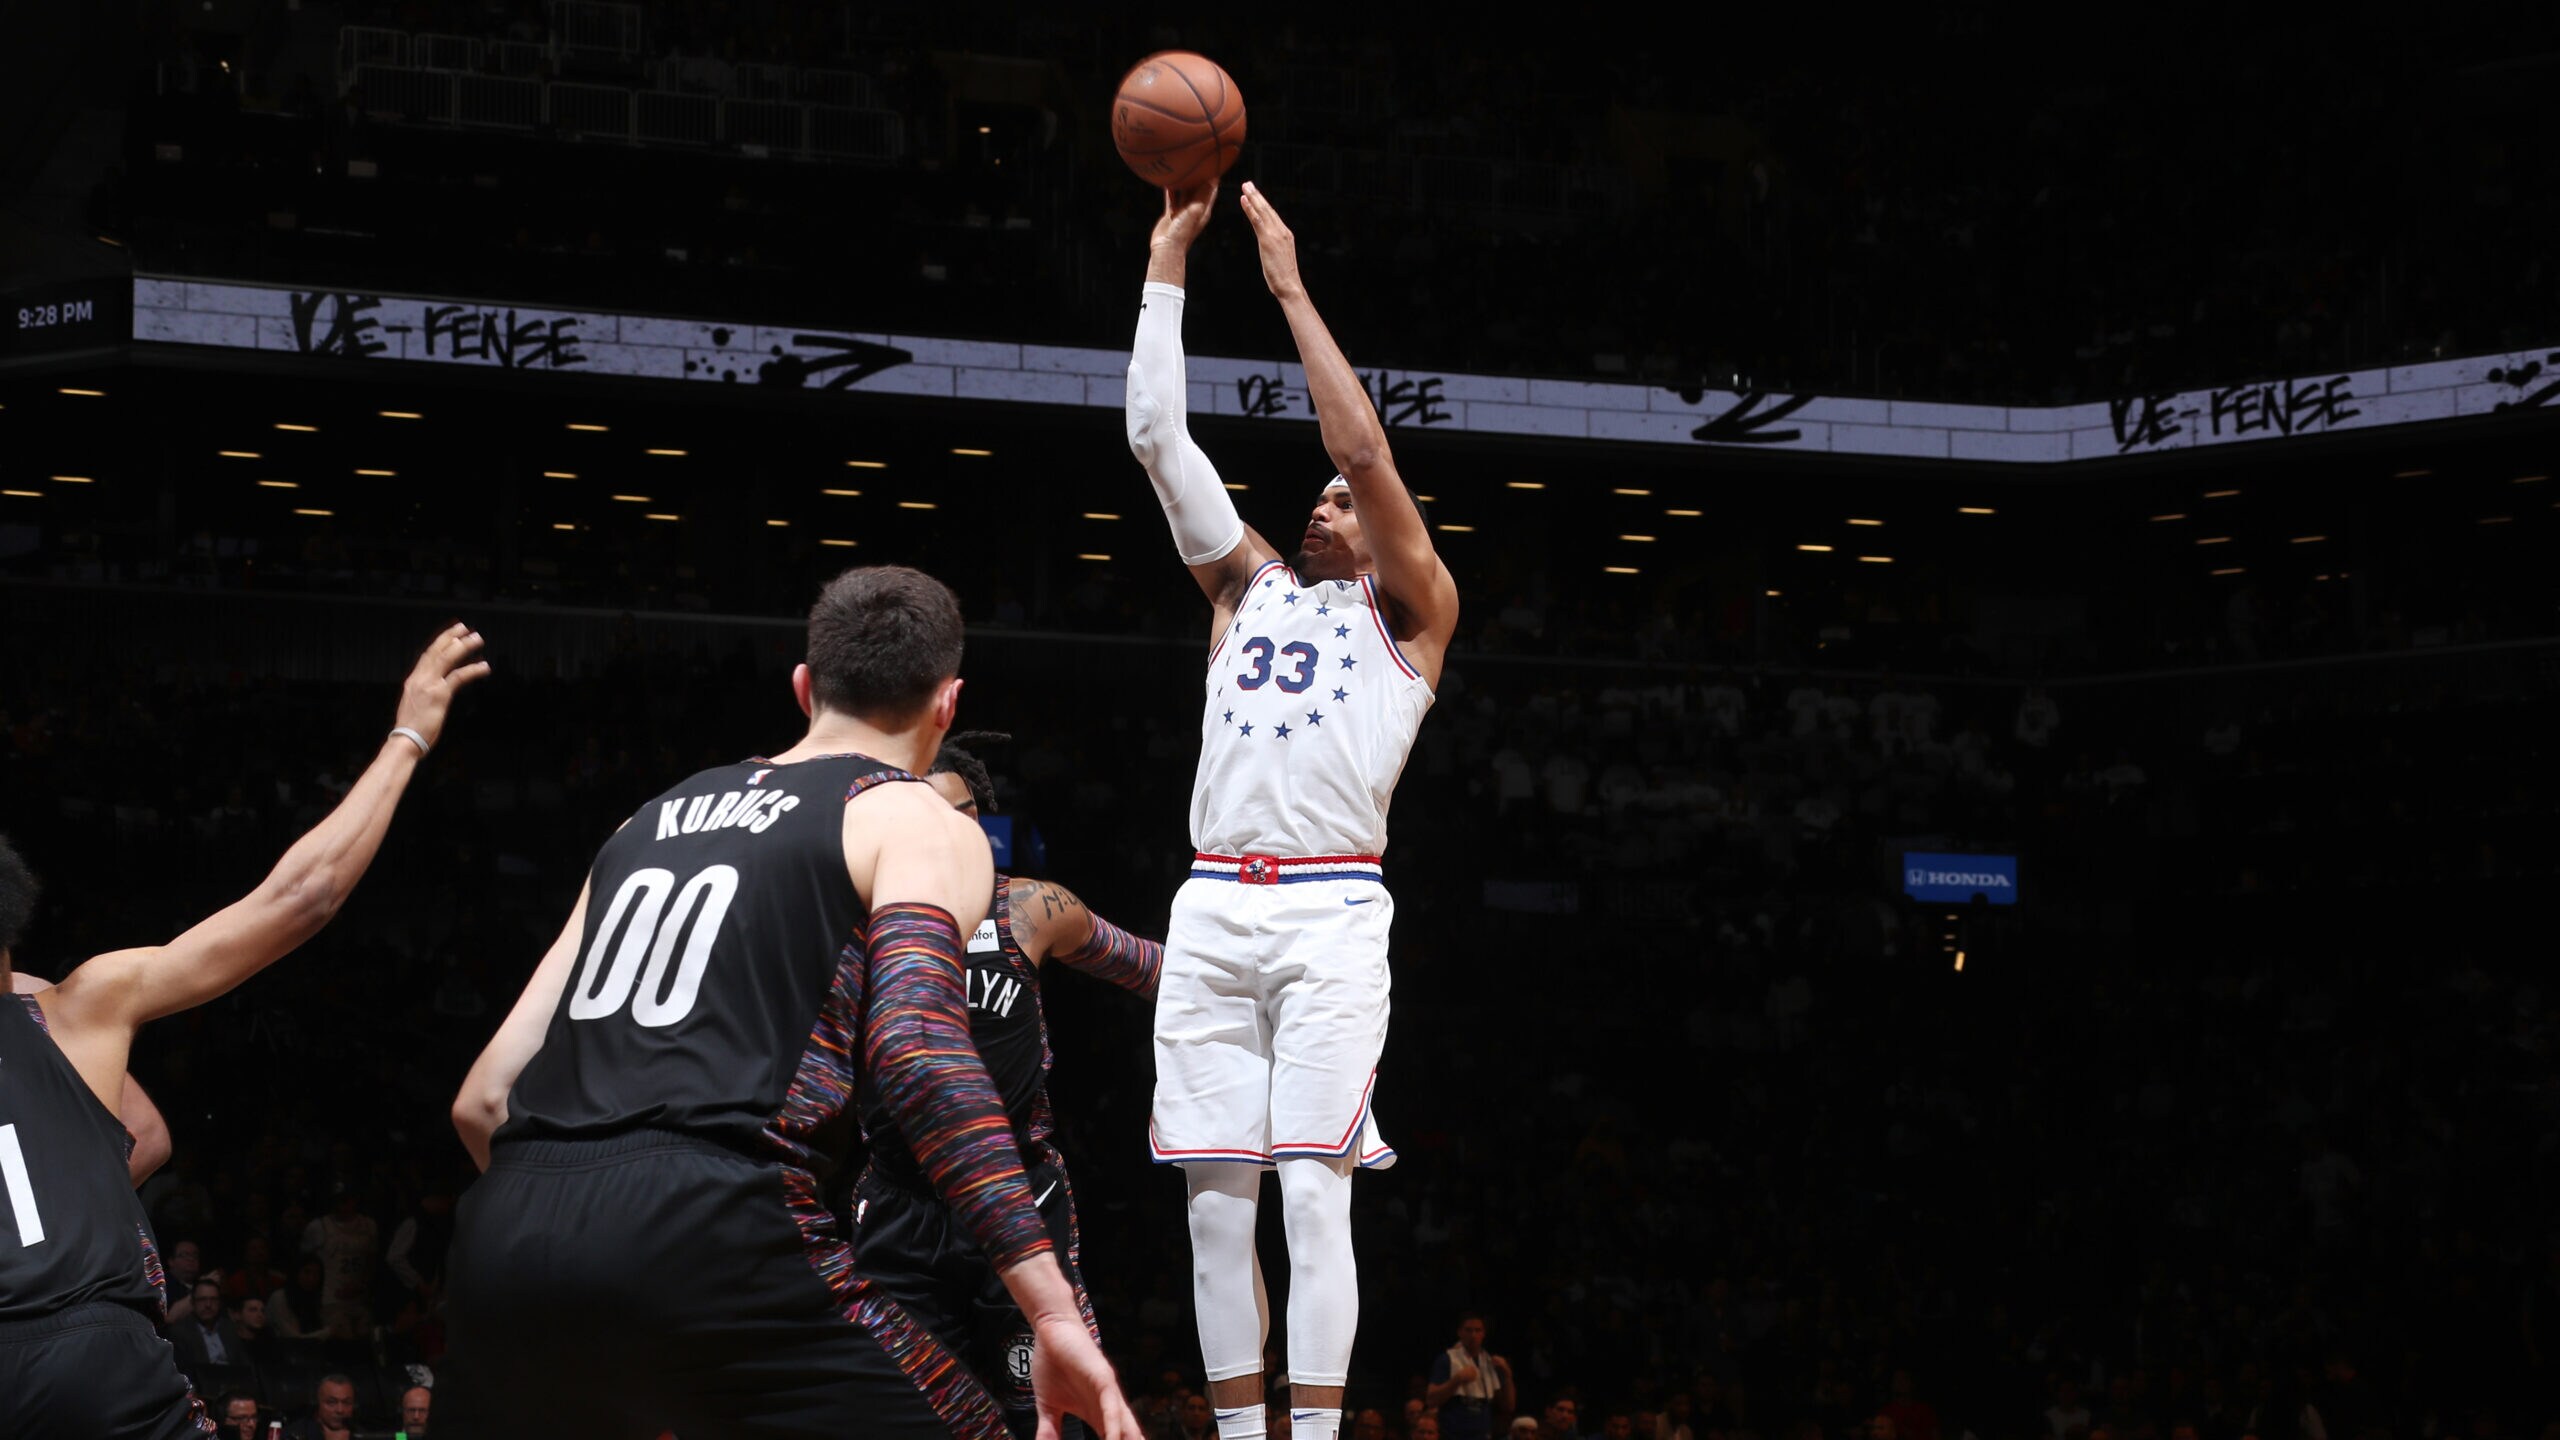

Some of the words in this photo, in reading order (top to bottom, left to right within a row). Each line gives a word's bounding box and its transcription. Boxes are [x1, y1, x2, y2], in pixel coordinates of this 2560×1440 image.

[19, 304, 57, 328] 9:28
[63, 301, 92, 323] PM
[1237, 637, 1319, 694] 33
[656, 789, 800, 841] KURUCS
[1928, 871, 2011, 887] HONDA
[569, 864, 739, 1027] 00
[970, 929, 994, 940] nfor
[966, 968, 1022, 1018] LYN
